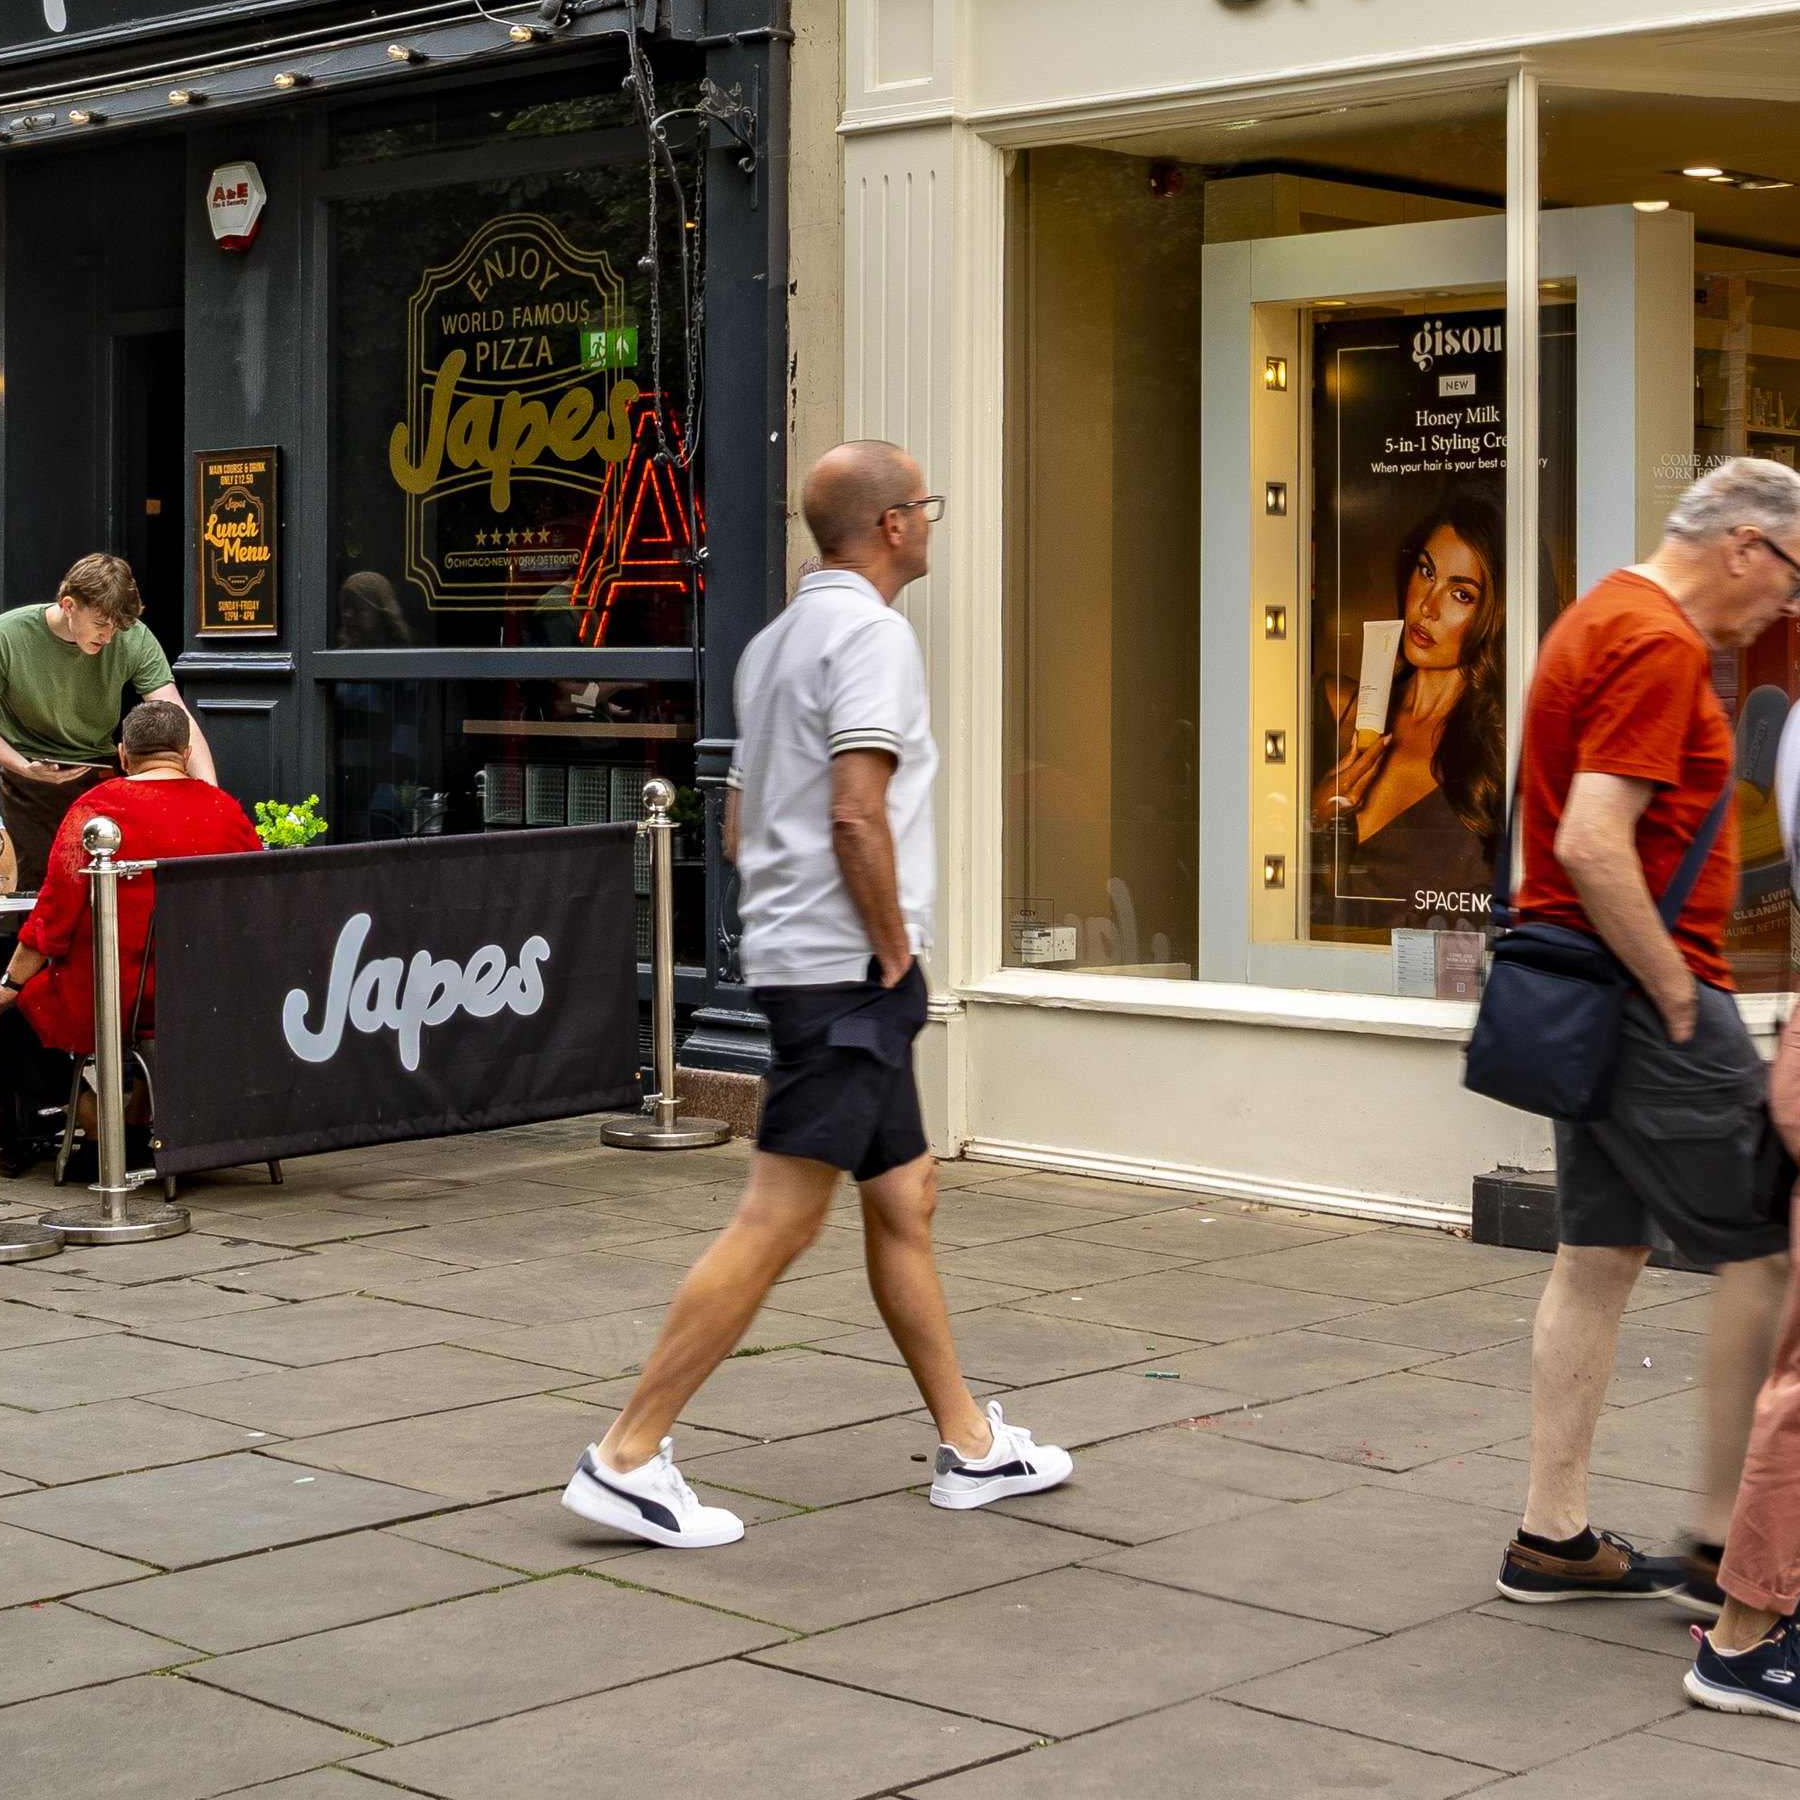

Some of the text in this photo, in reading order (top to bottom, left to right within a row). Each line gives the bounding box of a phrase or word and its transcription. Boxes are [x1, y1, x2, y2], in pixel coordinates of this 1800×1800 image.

[213, 182, 248, 201] A&E
[467, 246, 560, 301] ENJOY
[441, 299, 591, 335] WORLD FAMOUS
[476, 336, 553, 373] PIZZA
[1412, 320, 1503, 372] gisou
[1446, 381, 1469, 390] NEW
[1416, 406, 1500, 429] Honey Milk
[389, 349, 640, 513] Japes
[1385, 437, 1426, 453] 5-in-1
[1431, 434, 1480, 454] Styling
[209, 465, 222, 475] MAIN
[224, 463, 243, 474] COURSE
[249, 461, 265, 472] DRINK
[1371, 462, 1398, 473] When
[1401, 462, 1421, 475] your
[1424, 460, 1442, 471] hair
[1445, 459, 1453, 470] is
[1455, 460, 1475, 472] your
[1478, 458, 1498, 469] best
[221, 475, 233, 485] ONLY
[205, 513, 258, 547] Lunch
[223, 538, 271, 563] Menu
[224, 611, 238, 621] 12PM
[243, 611, 255, 621] 4PM
[283, 913, 550, 1071] Japes
